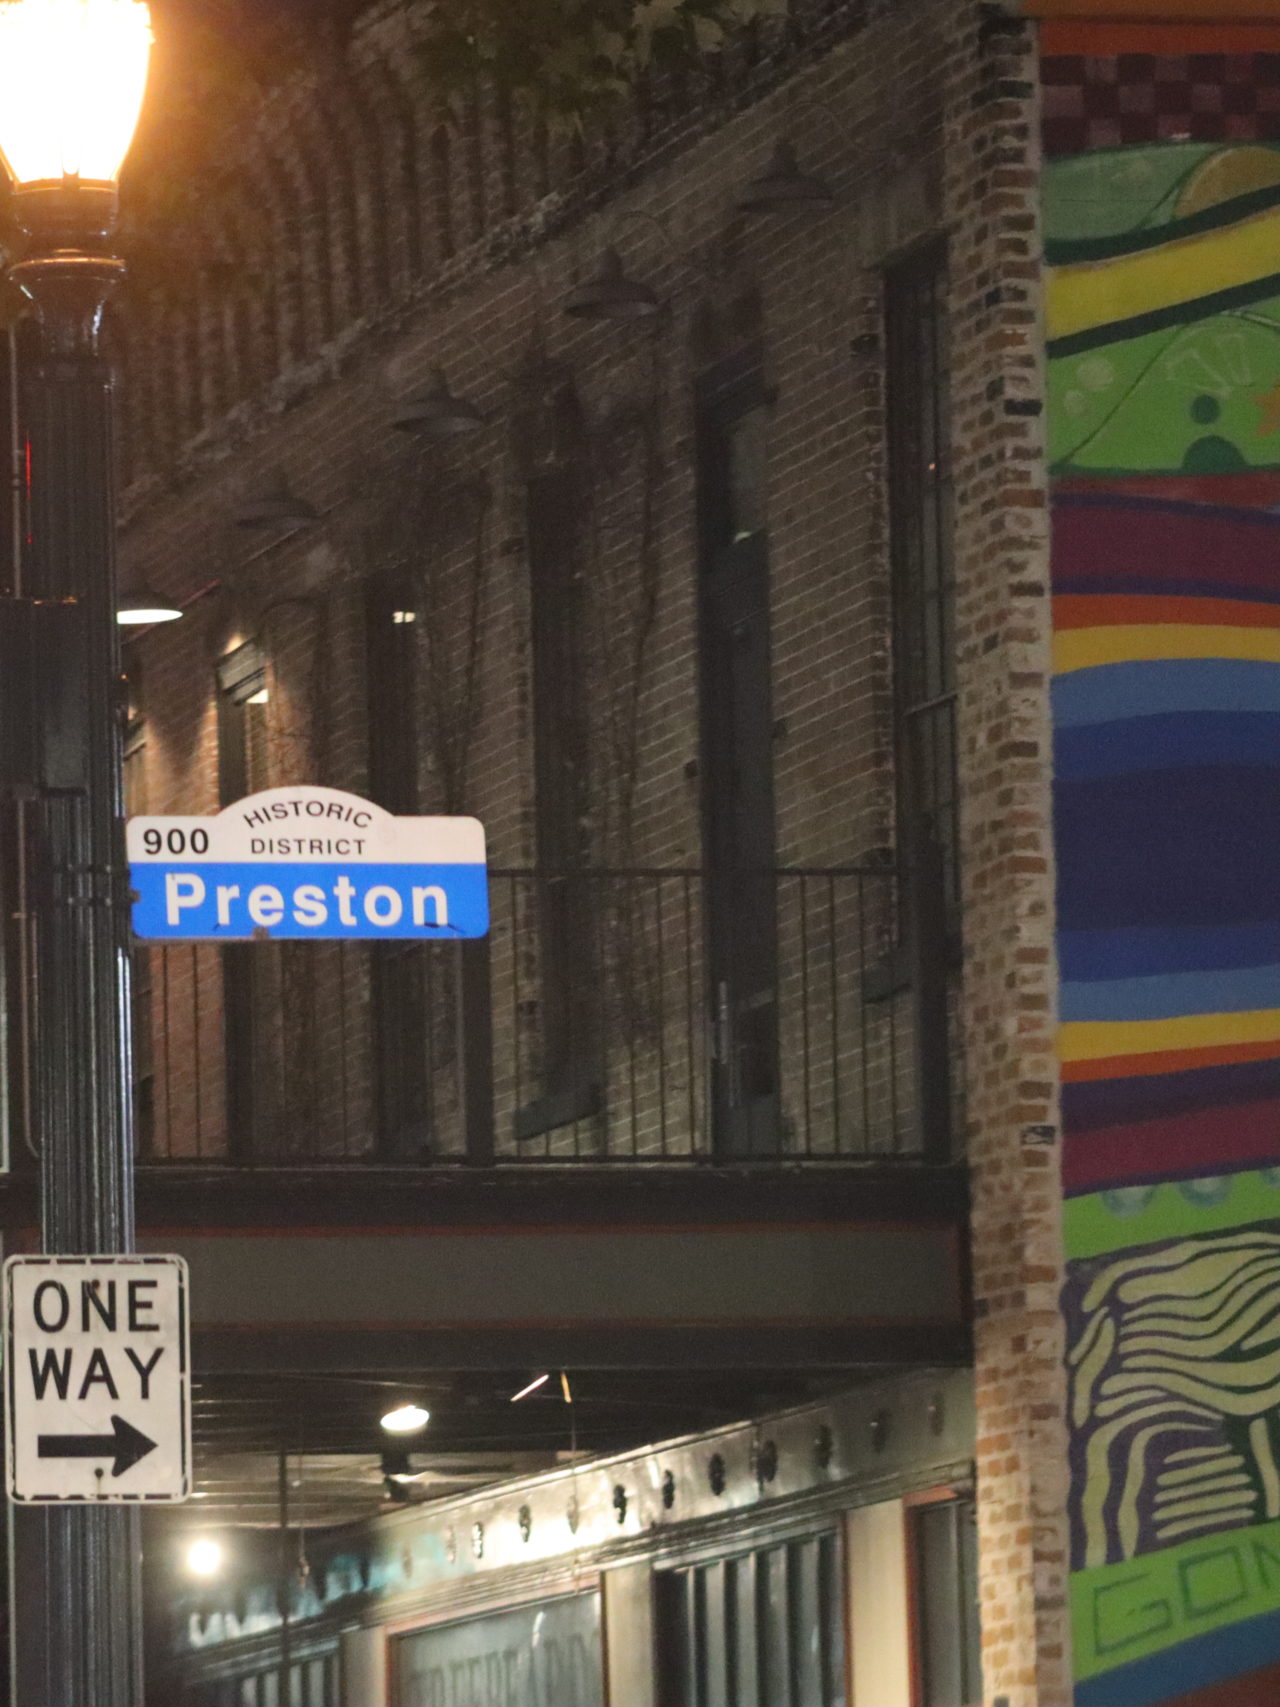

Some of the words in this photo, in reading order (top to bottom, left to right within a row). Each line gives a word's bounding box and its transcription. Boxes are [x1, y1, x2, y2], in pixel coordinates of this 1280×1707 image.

[243, 800, 372, 830] HISTORIC
[143, 828, 210, 856] 900
[251, 838, 367, 855] DISTRICT
[165, 872, 450, 927] Preston
[33, 1279, 161, 1334] ONE
[28, 1347, 166, 1401] WAY
